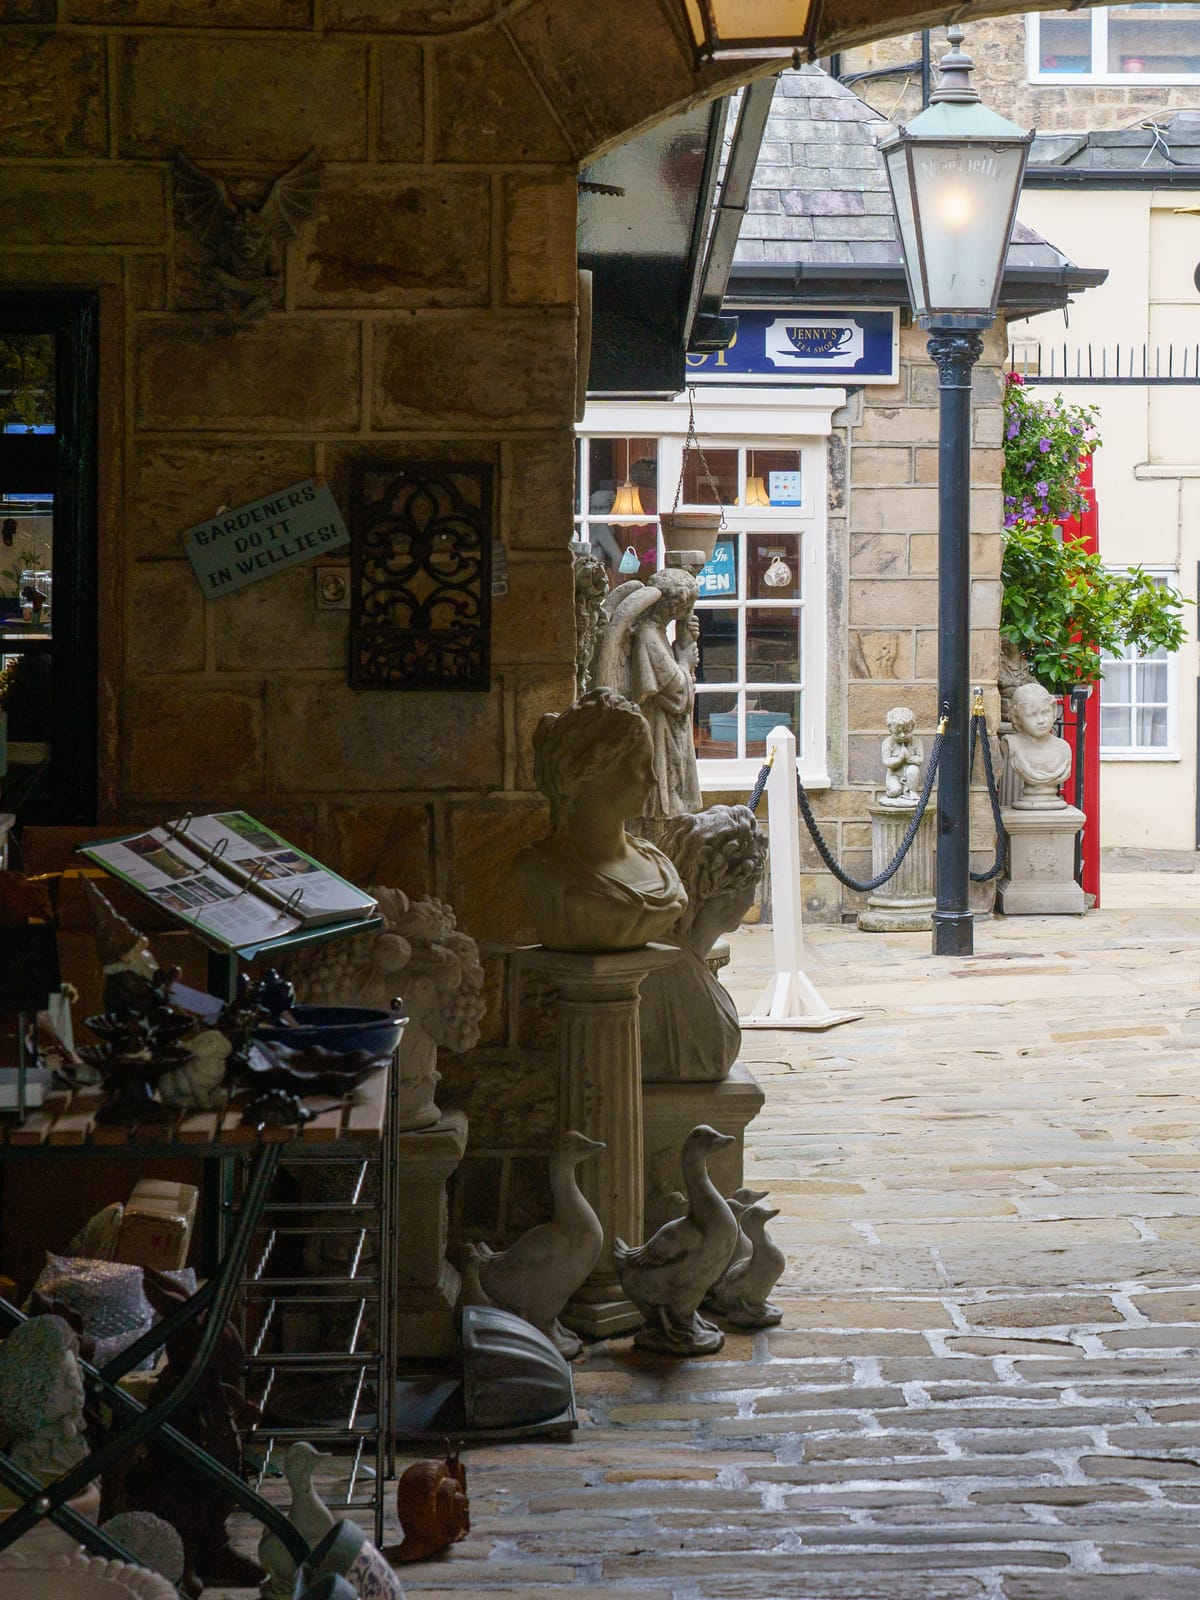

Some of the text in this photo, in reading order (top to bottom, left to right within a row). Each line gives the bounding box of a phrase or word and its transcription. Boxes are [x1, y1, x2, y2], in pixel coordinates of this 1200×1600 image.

[791, 327, 837, 340] JENNY'S
[796, 340, 834, 353] TEA SHOP
[193, 485, 316, 546] GARDENERS
[233, 518, 292, 554] DO IT
[206, 524, 338, 589] IN WELLIES!
[712, 548, 728, 562] In
[696, 573, 729, 591] PEN
